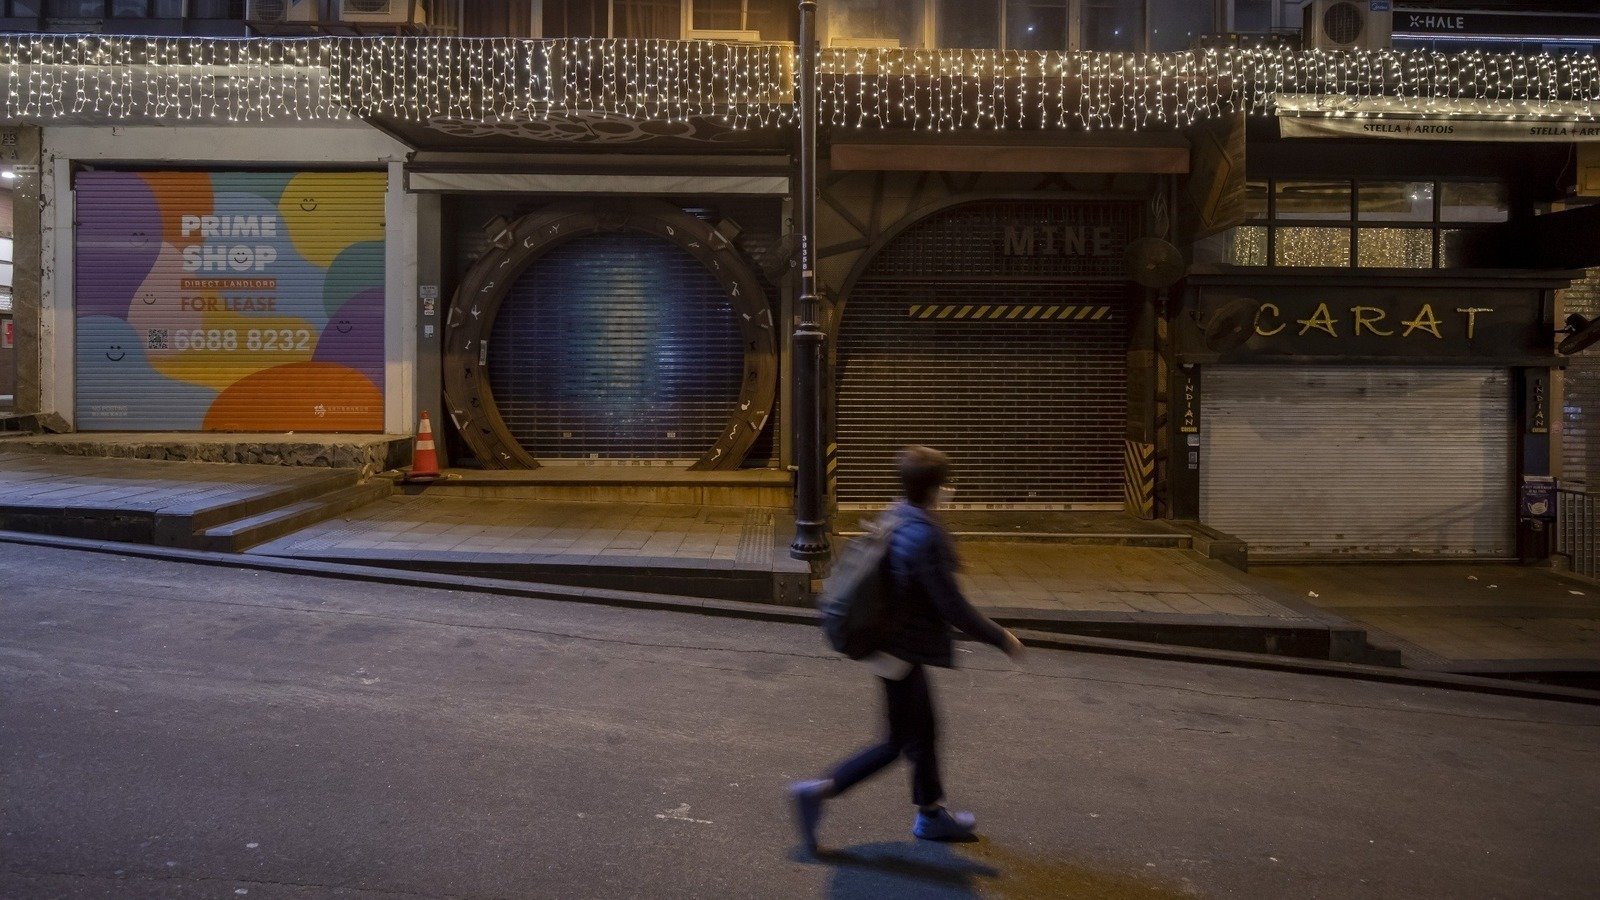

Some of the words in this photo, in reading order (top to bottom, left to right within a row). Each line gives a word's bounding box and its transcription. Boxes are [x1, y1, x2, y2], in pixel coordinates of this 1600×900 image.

[1409, 15, 1464, 29] X-HALE
[1363, 124, 1402, 133] STELLA
[1414, 125, 1454, 134] ARTOIS
[1529, 127, 1567, 136] STELLA
[181, 215, 277, 238] PRIME
[1004, 225, 1112, 256] MINE
[182, 245, 278, 272] SHOP
[184, 280, 220, 288] DIRECT
[223, 280, 276, 288] LANDLORD
[181, 297, 218, 312] FOR
[224, 297, 277, 312] LEASE
[1254, 302, 1494, 339] CARAT
[174, 329, 238, 351] 6688
[246, 329, 311, 351] 8232
[1184, 377, 1195, 426] INDIAN
[1535, 378, 1544, 427] INDIAN
